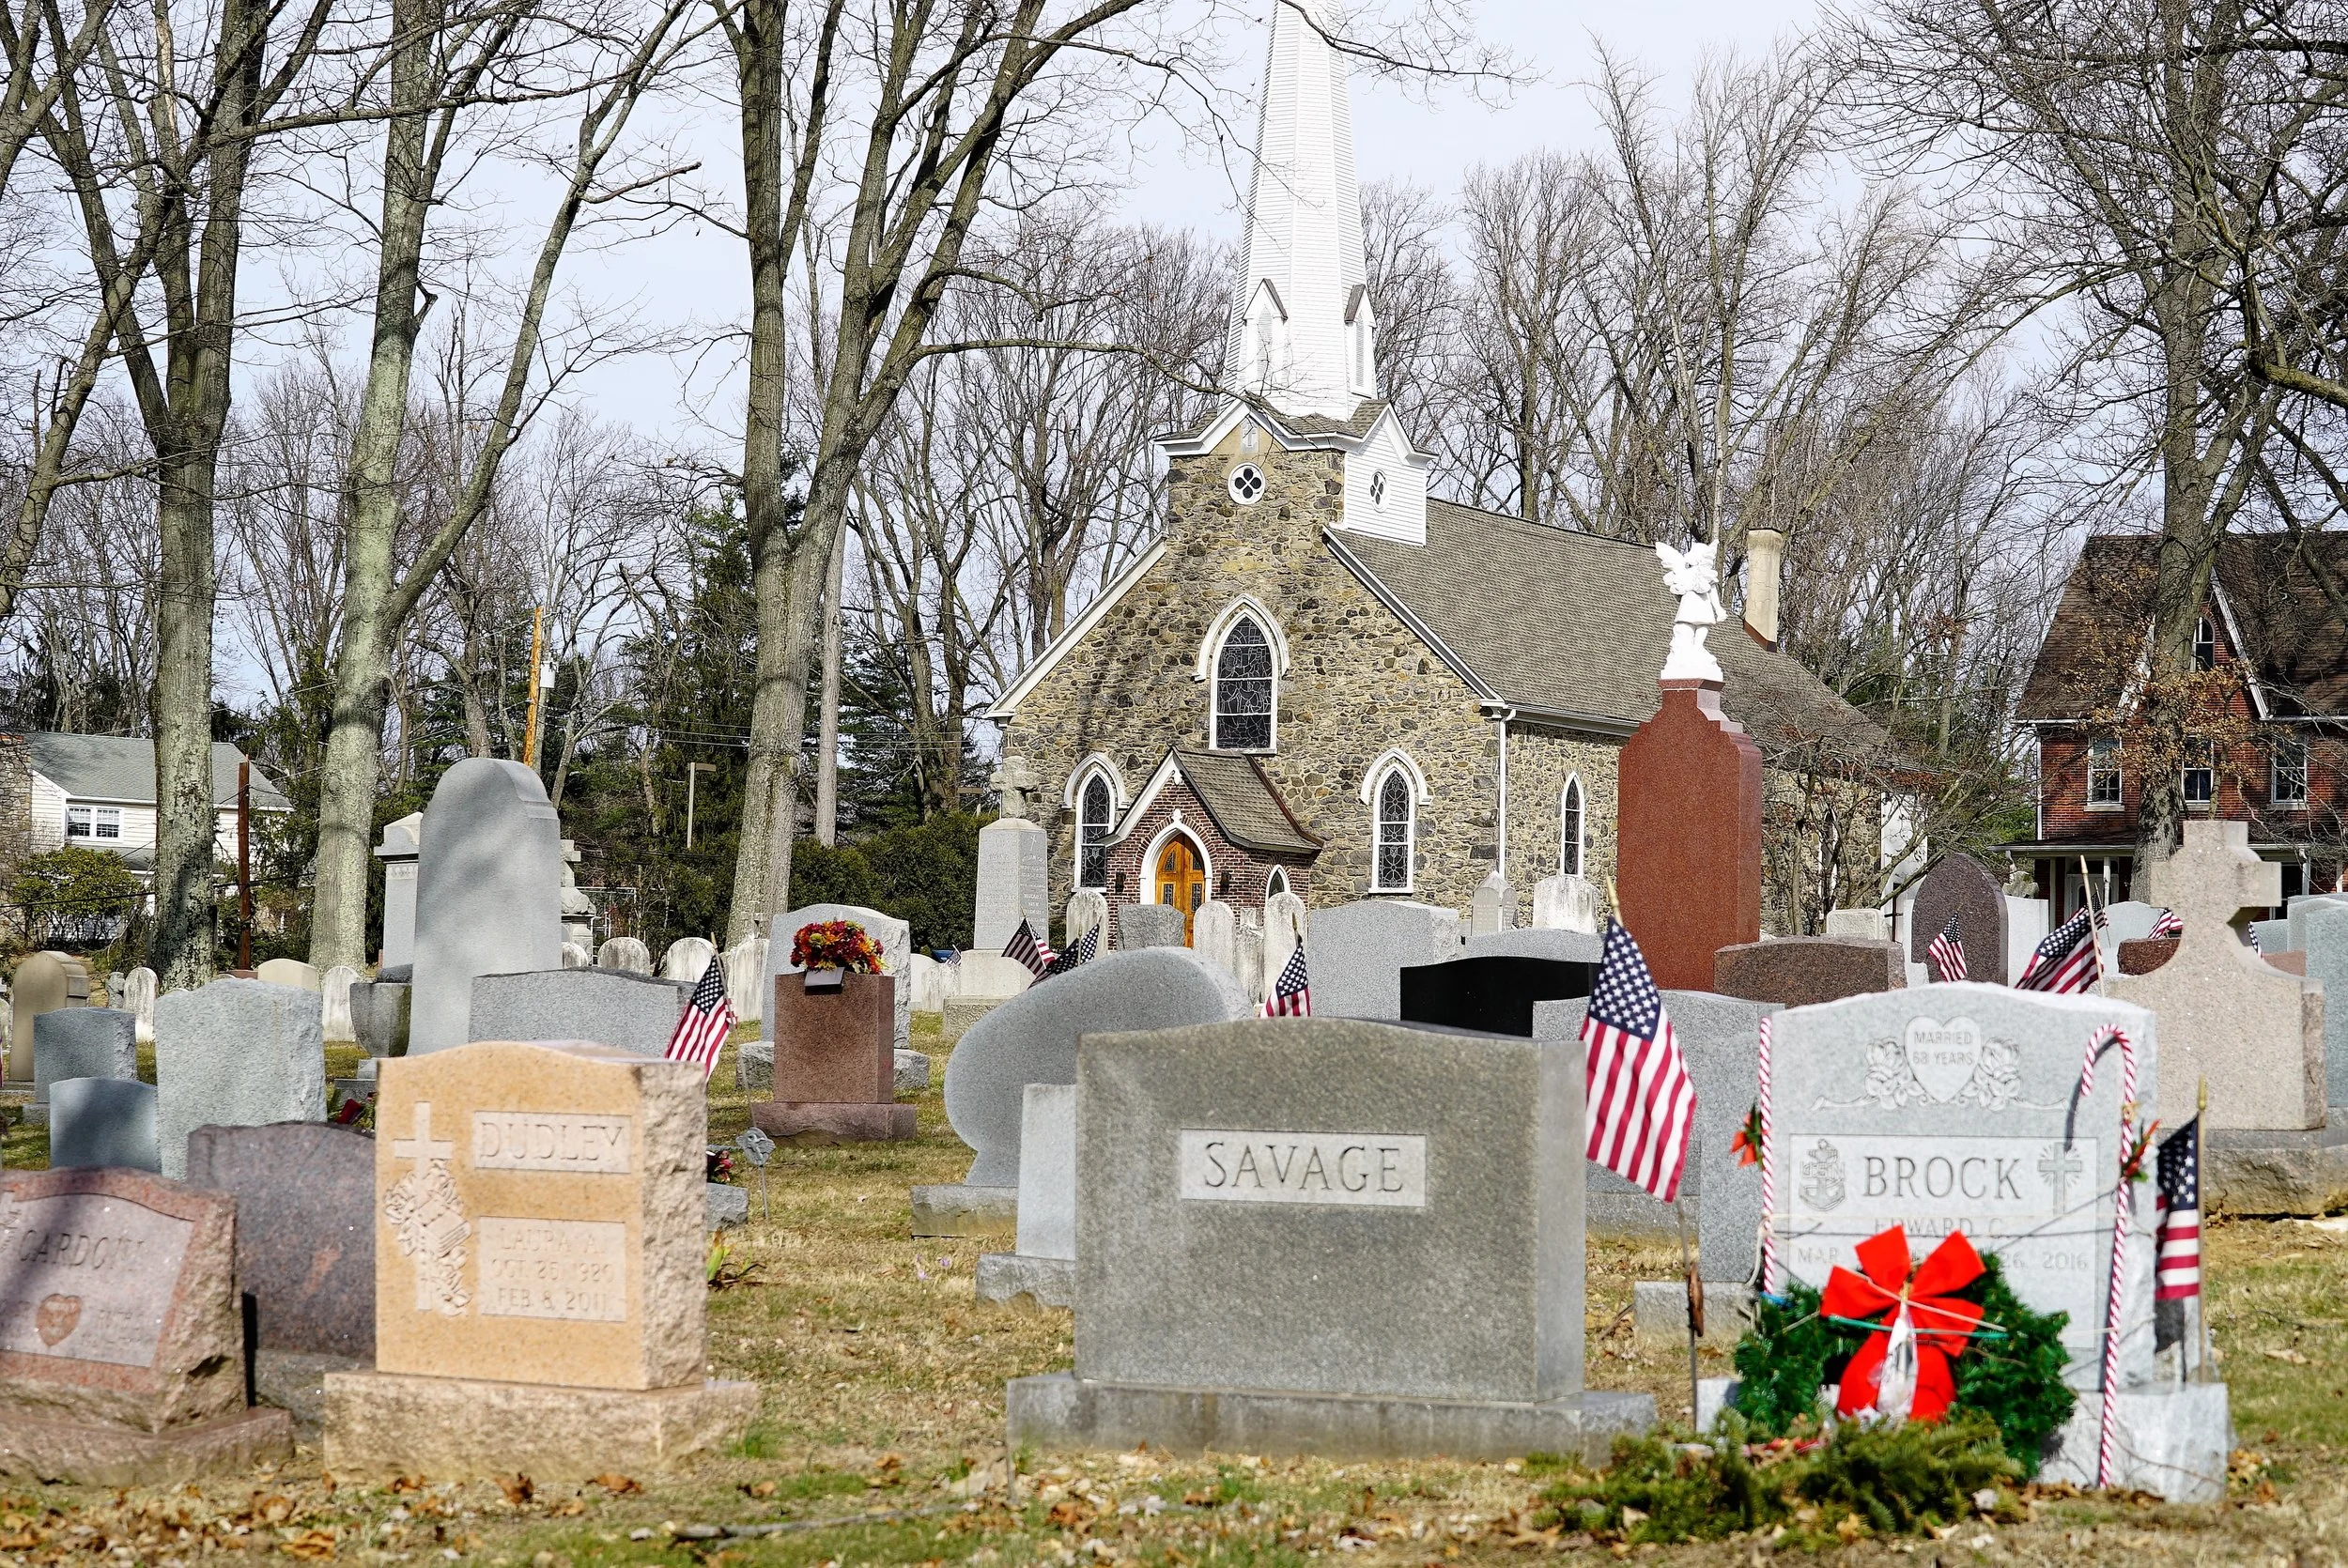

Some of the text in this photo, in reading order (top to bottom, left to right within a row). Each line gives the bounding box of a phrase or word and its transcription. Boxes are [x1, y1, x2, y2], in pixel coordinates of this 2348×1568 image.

[1914, 1031, 1972, 1045] MARRIED
[1934, 1052, 1973, 1066] YEARS
[479, 1122, 624, 1161] DUDLEY
[1204, 1142, 1403, 1192] SAVAGE
[1861, 1156, 2022, 1199] BROCK
[2042, 1252, 2088, 1271] 2016
